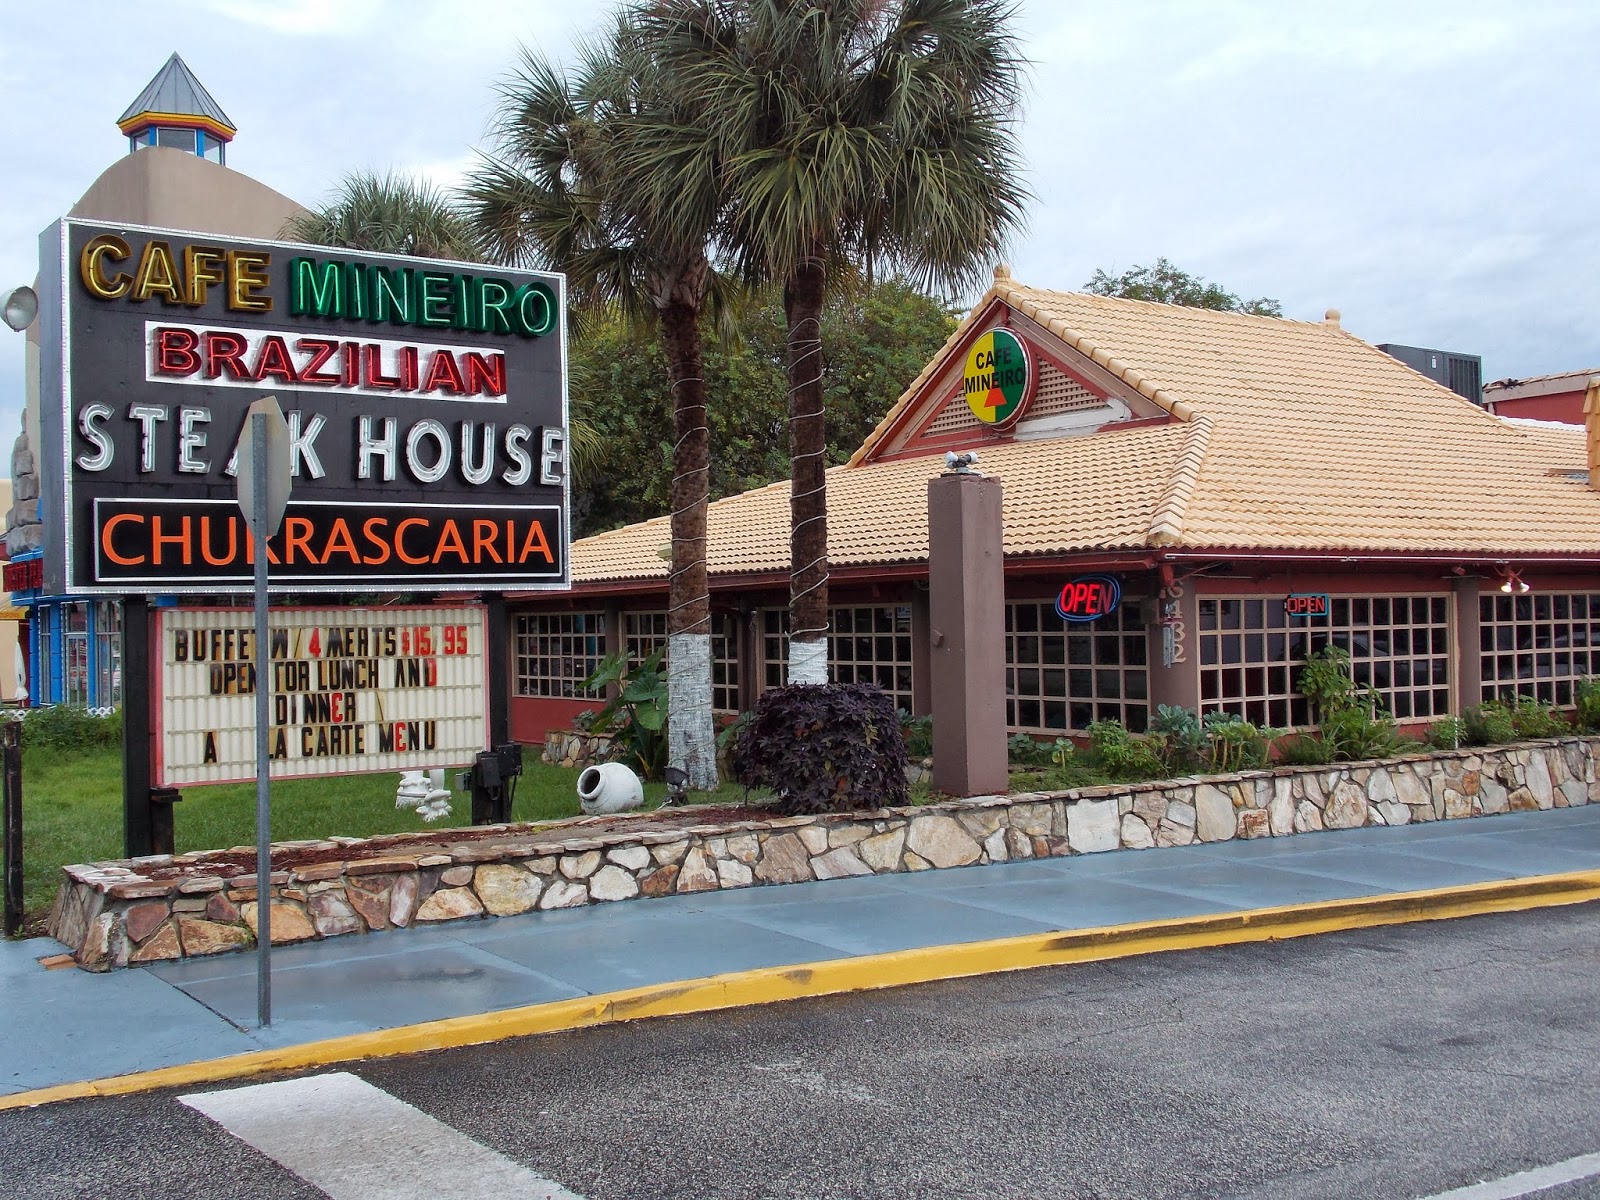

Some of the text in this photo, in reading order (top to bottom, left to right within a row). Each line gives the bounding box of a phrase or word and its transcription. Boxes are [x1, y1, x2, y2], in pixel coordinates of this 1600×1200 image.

[81, 234, 559, 338] CAFE MINEIRO
[153, 327, 507, 396] BRAZILIAN
[976, 346, 1012, 369] CAFE
[965, 367, 1025, 394] MINEIRO
[75, 402, 565, 486] STEK HOUSE
[1060, 583, 1114, 614] OPEN
[1286, 597, 1326, 613] OPEN
[175, 629, 257, 661] BUFFE
[308, 627, 321, 659] 4
[326, 626, 397, 657] MEATS
[318, 659, 379, 690] LUNCH
[275, 692, 356, 725] DINNER
[203, 720, 436, 763] A A CARTE MENU
